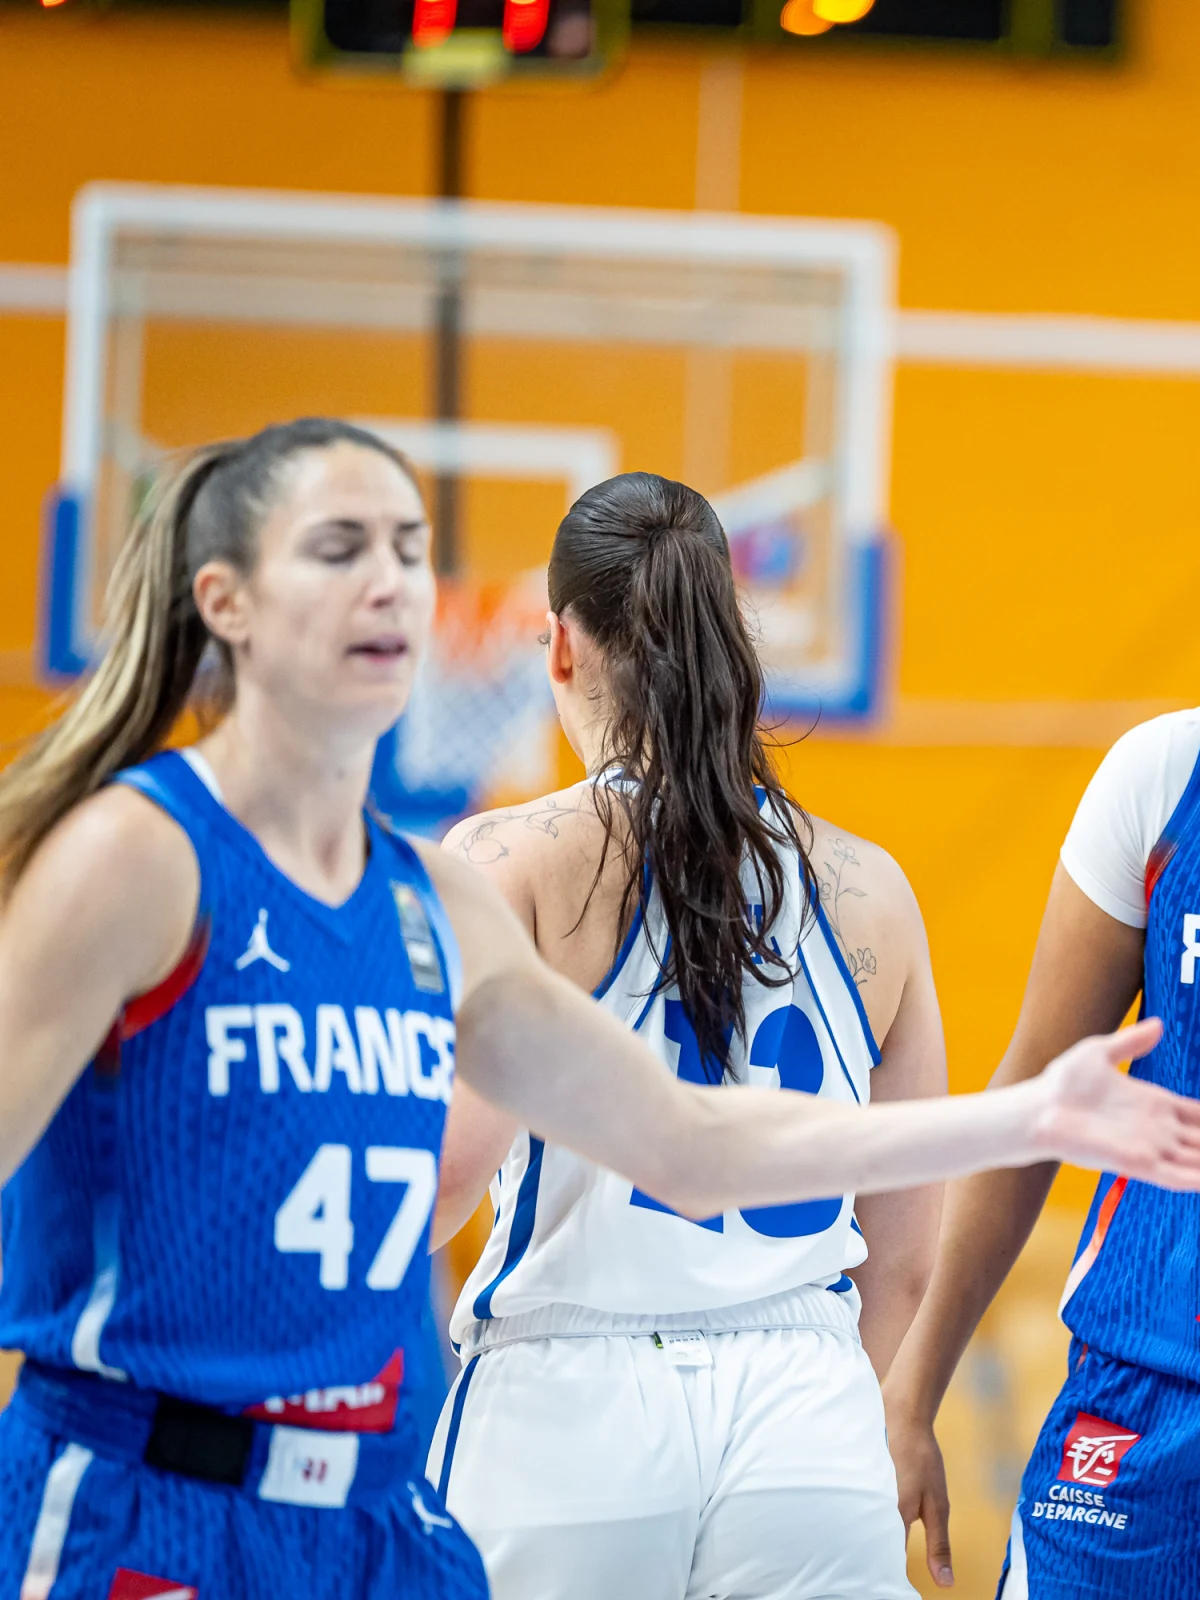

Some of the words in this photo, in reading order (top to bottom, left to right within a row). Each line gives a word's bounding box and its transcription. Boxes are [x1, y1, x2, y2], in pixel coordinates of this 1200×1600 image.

[274, 1143, 437, 1291] 47
[1048, 1484, 1106, 1508] CAISSE
[1031, 1502, 1129, 1531] D'EPARGNE
